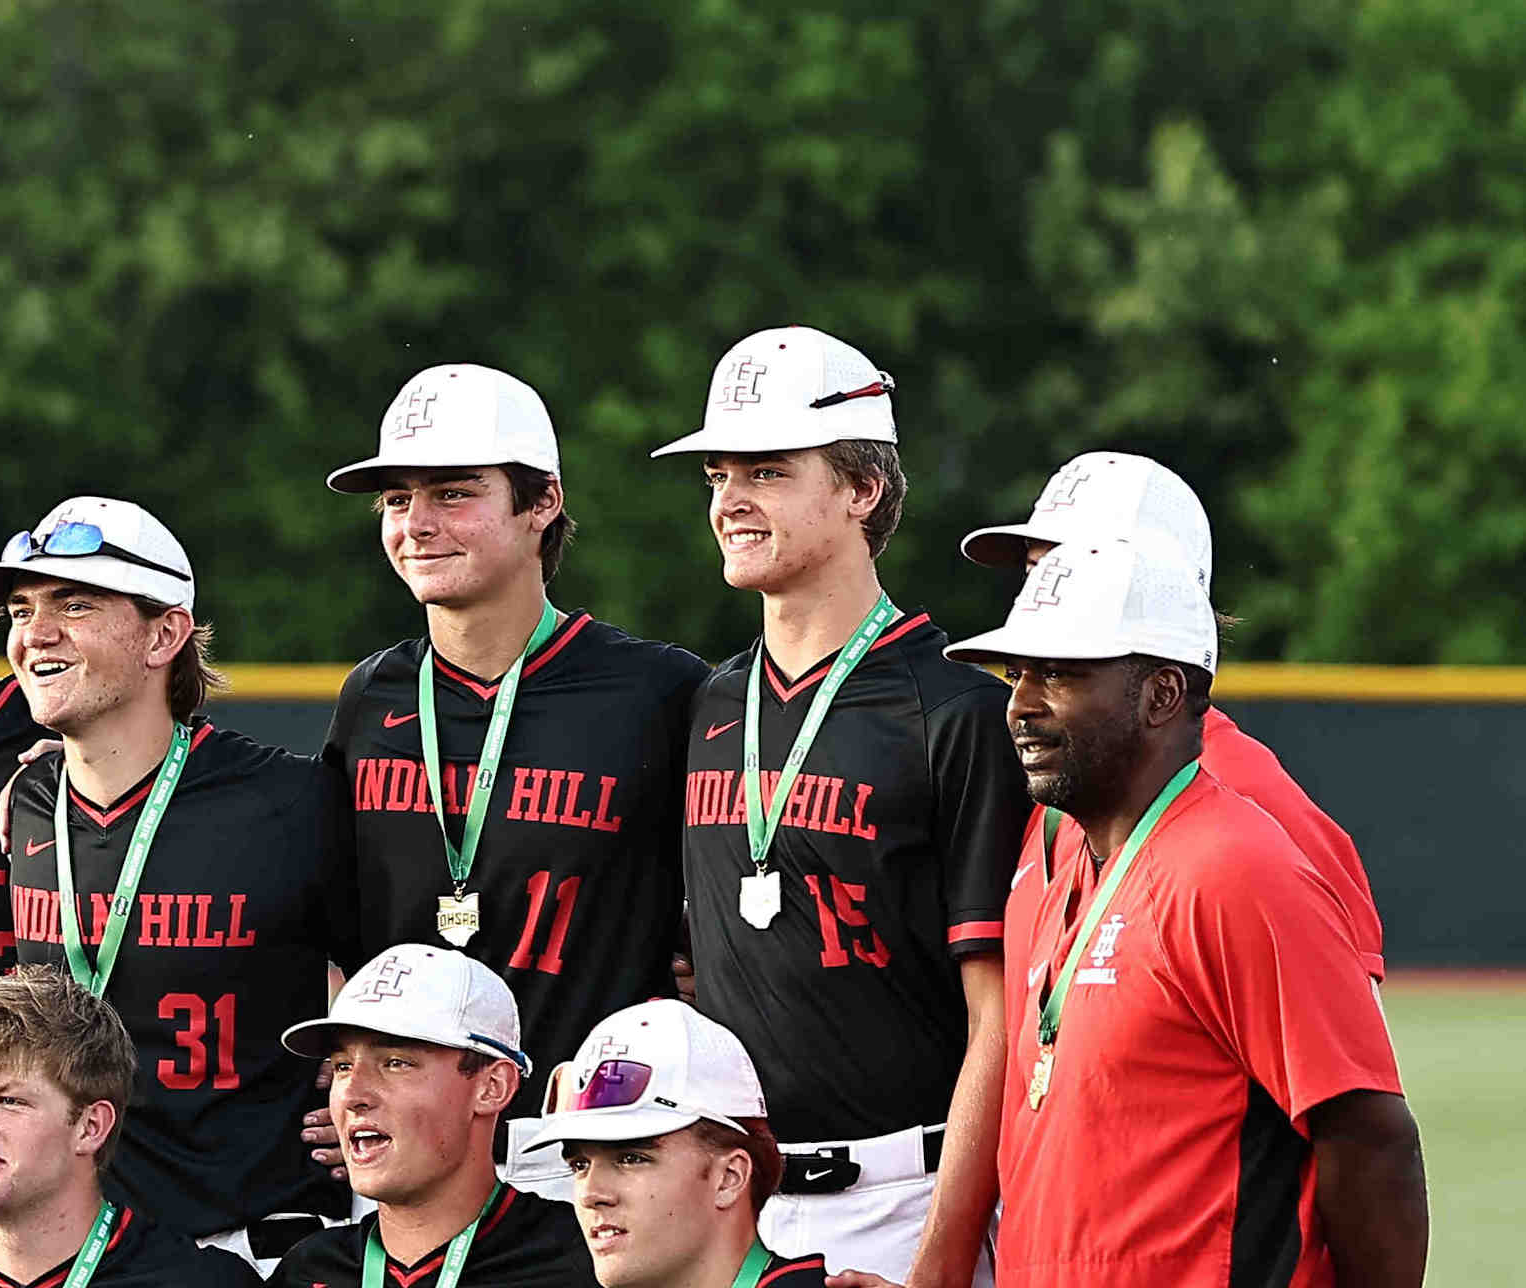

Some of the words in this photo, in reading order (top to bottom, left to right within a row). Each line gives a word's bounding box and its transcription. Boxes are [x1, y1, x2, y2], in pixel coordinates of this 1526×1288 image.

[506, 768, 621, 832] HILL
[781, 774, 877, 840] HILL
[139, 894, 256, 948] HILL
[440, 913, 477, 926] OHSAA
[509, 871, 580, 975] 11
[805, 875, 890, 968] 15
[158, 993, 240, 1090] 31
